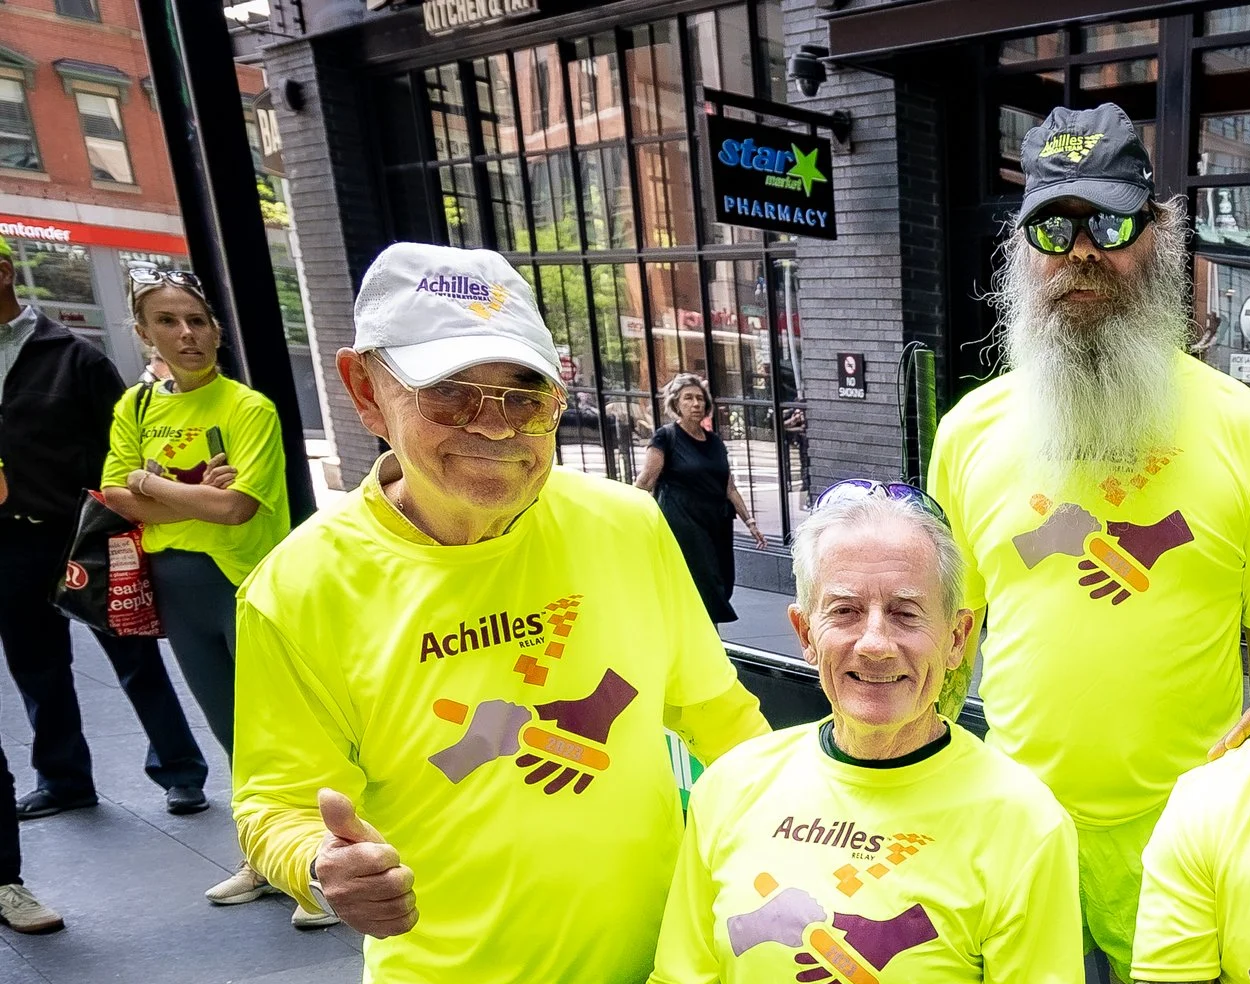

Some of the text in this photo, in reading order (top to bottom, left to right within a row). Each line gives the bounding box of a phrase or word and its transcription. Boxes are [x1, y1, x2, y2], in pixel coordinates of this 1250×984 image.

[423, 0, 488, 33] KITCHEN
[718, 138, 795, 174] star
[765, 175, 802, 191] market
[723, 195, 827, 228] PHARMACY
[416, 275, 489, 296] Achilles
[419, 610, 544, 664] Achilles
[518, 636, 546, 649] RELAY
[545, 736, 583, 761] 2023
[772, 816, 885, 853] Achilles
[851, 852, 876, 861] RELAY
